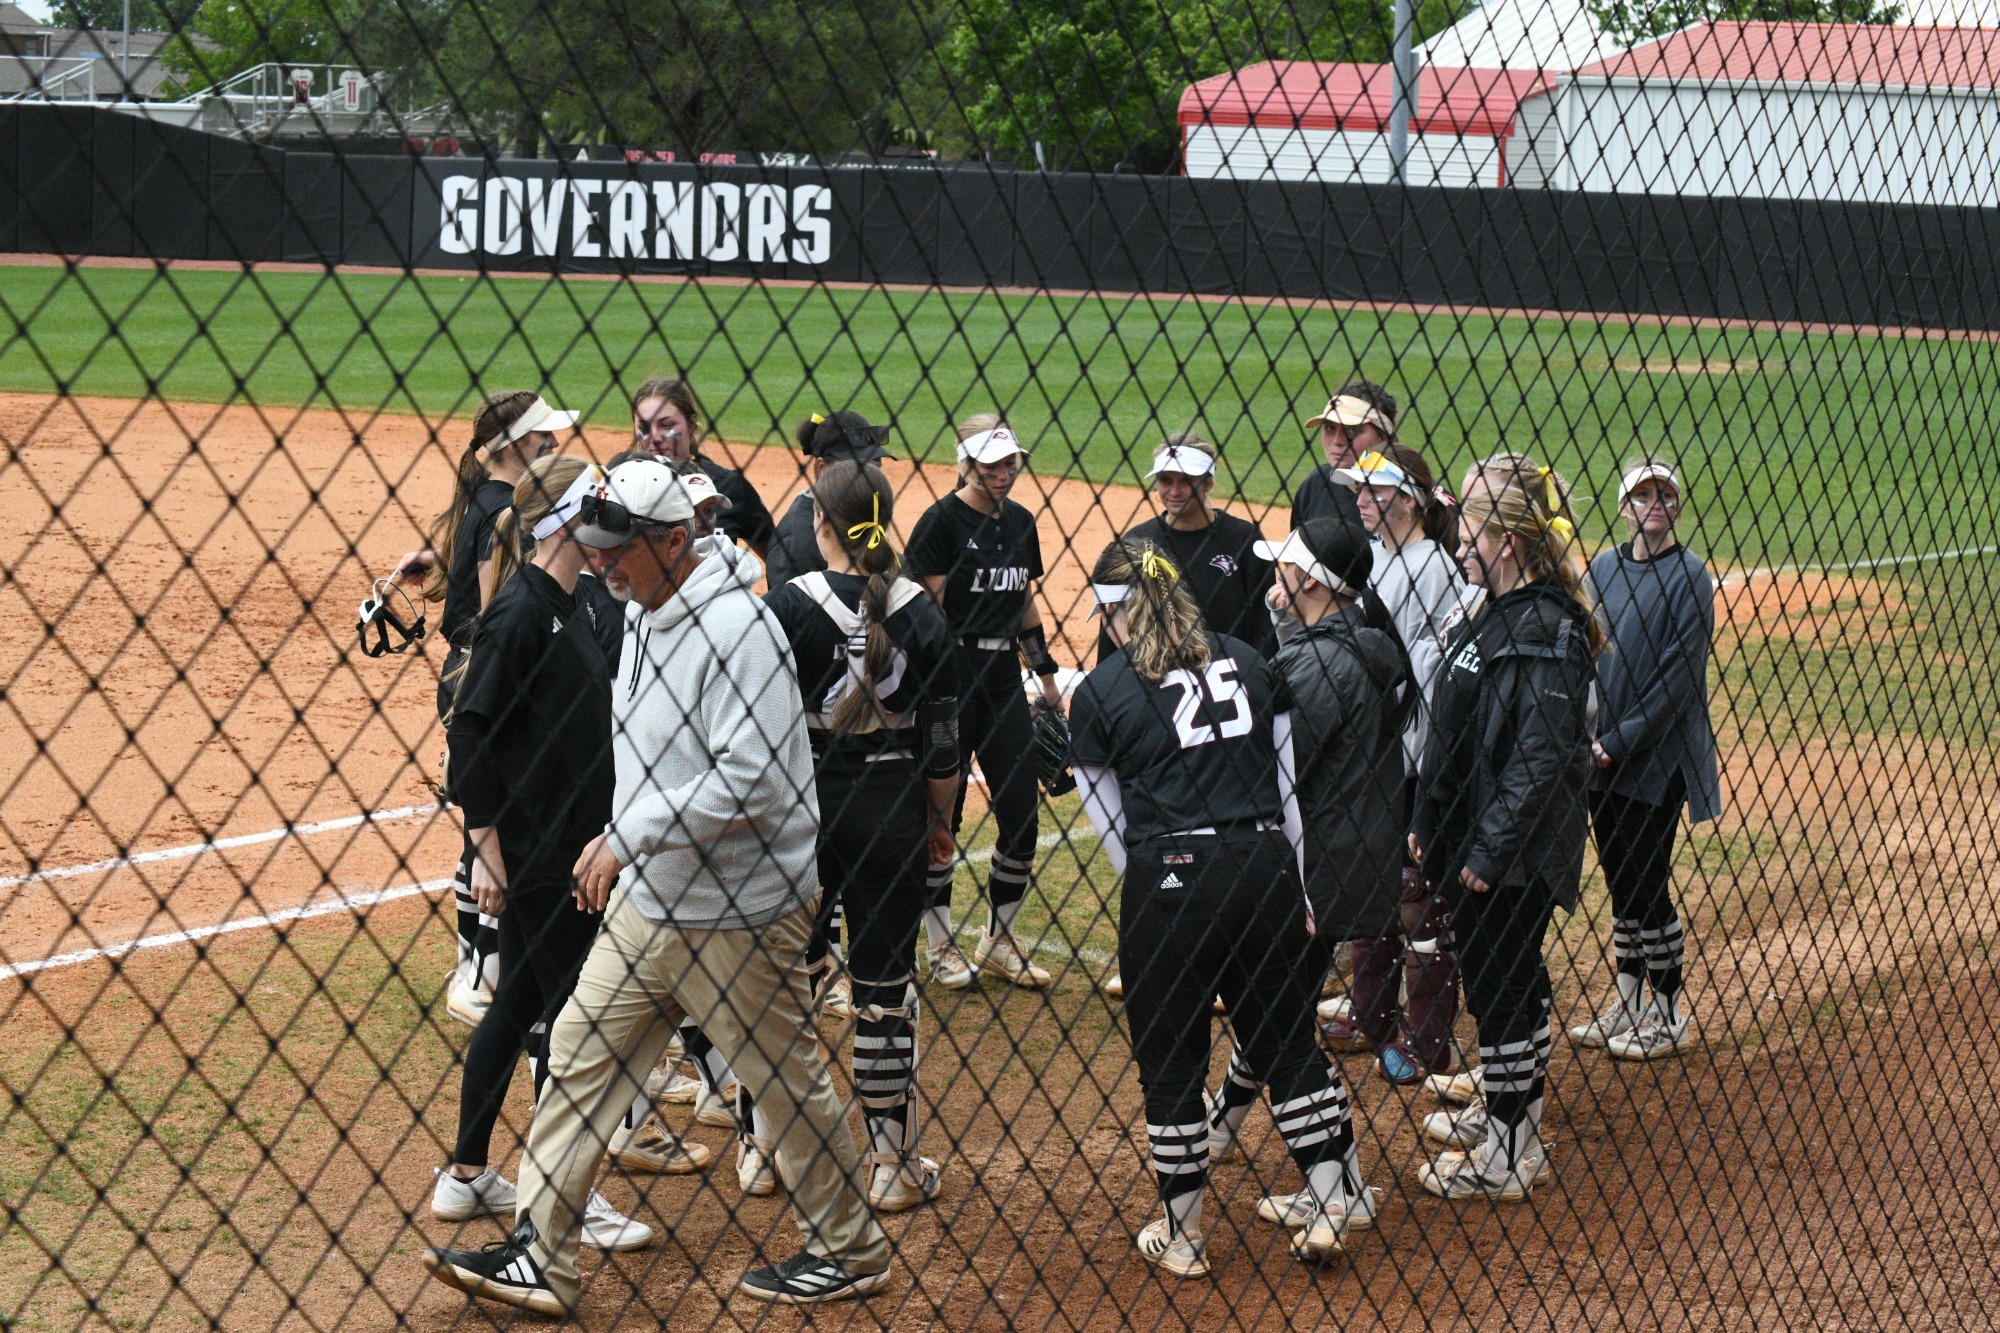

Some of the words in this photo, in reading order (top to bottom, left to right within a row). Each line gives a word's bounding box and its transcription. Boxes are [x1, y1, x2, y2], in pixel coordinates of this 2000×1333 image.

[439, 175, 832, 264] GOVERNORS
[970, 567, 1029, 592] LIONS
[1159, 658, 1253, 749] 25
[1161, 881, 1183, 889] adidas
